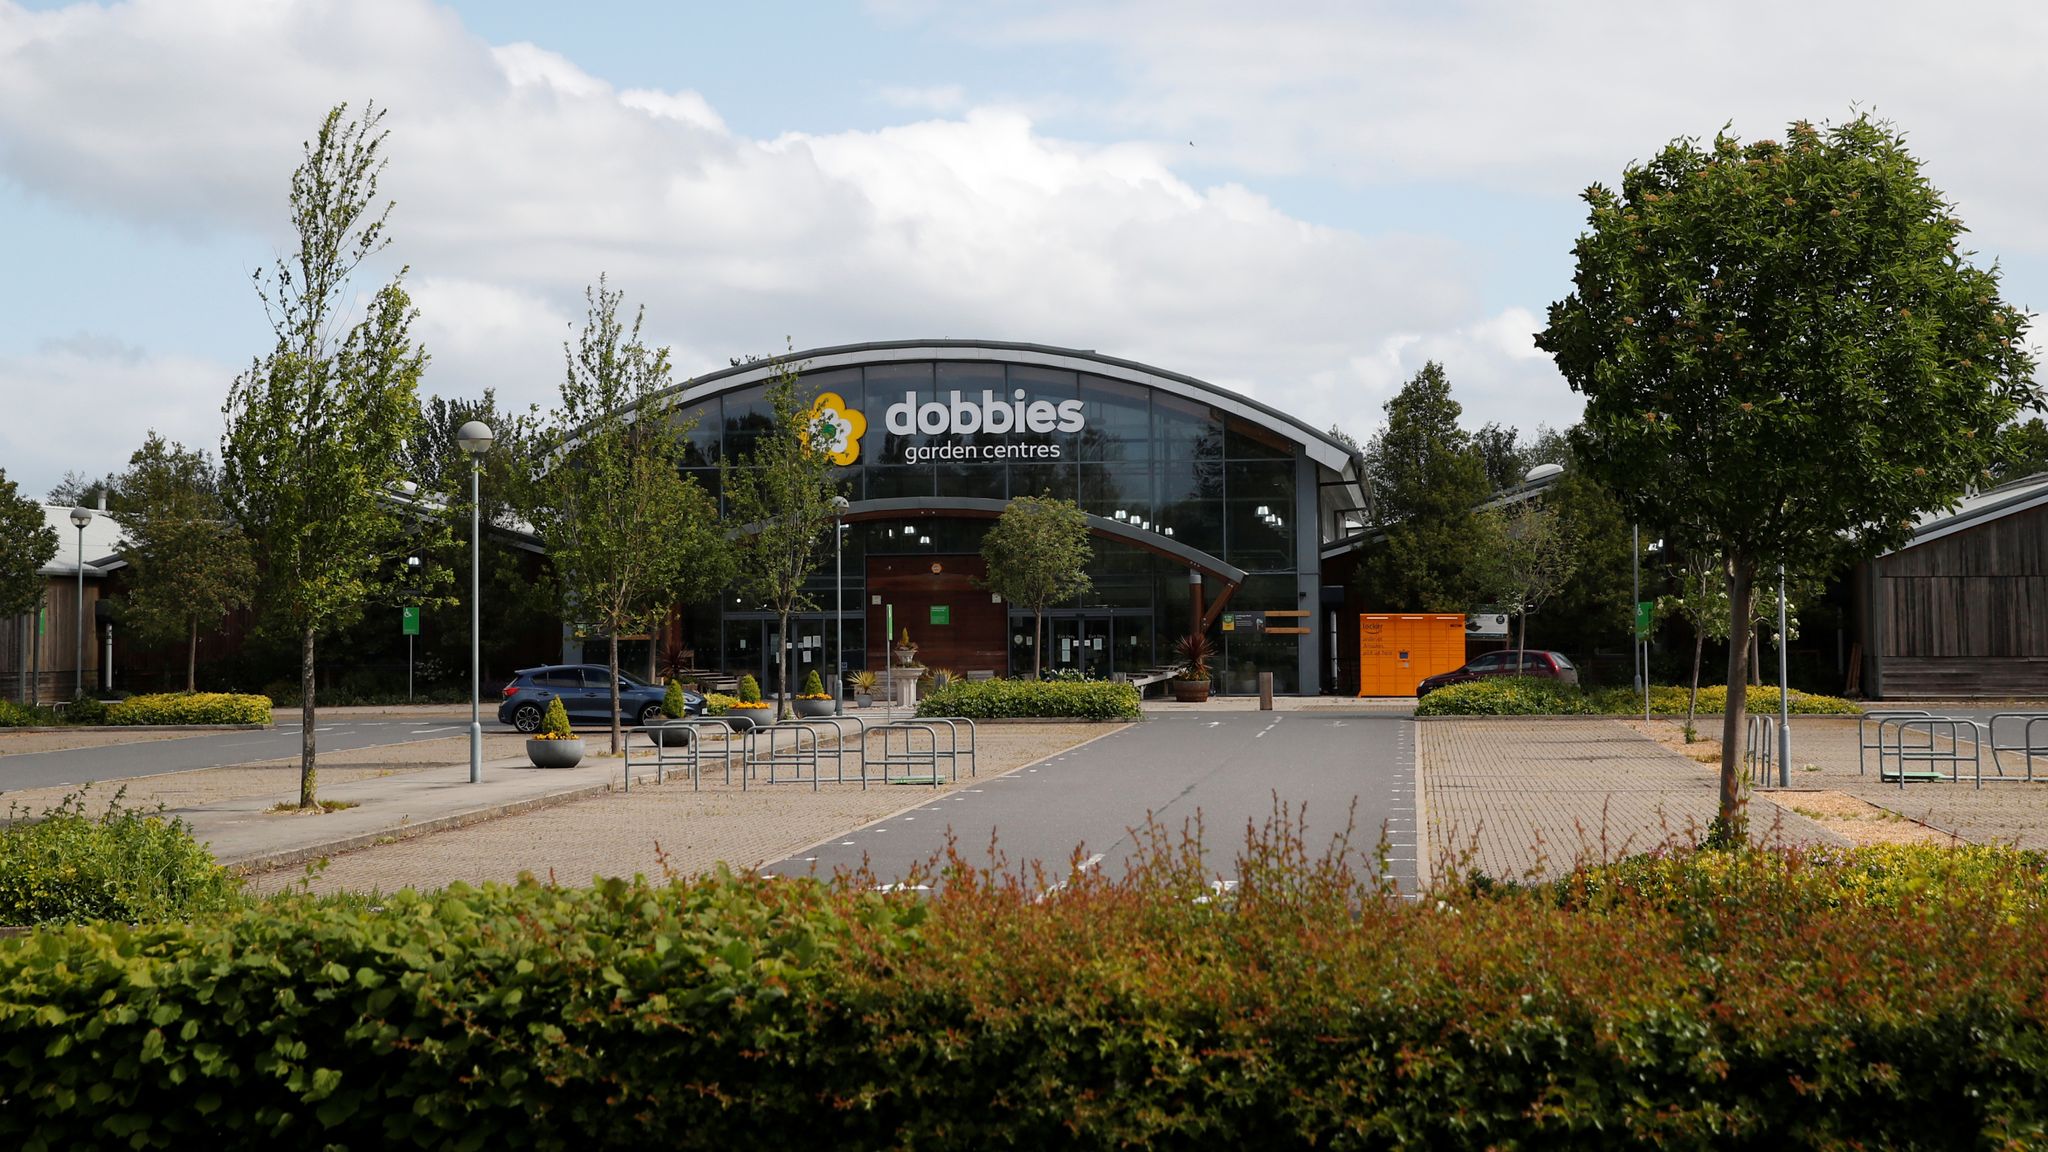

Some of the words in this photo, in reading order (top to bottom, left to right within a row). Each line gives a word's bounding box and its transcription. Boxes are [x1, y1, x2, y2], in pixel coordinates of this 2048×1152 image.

[886, 389, 1085, 435] dobbies
[905, 440, 977, 464] garden
[983, 441, 1060, 459] centres
